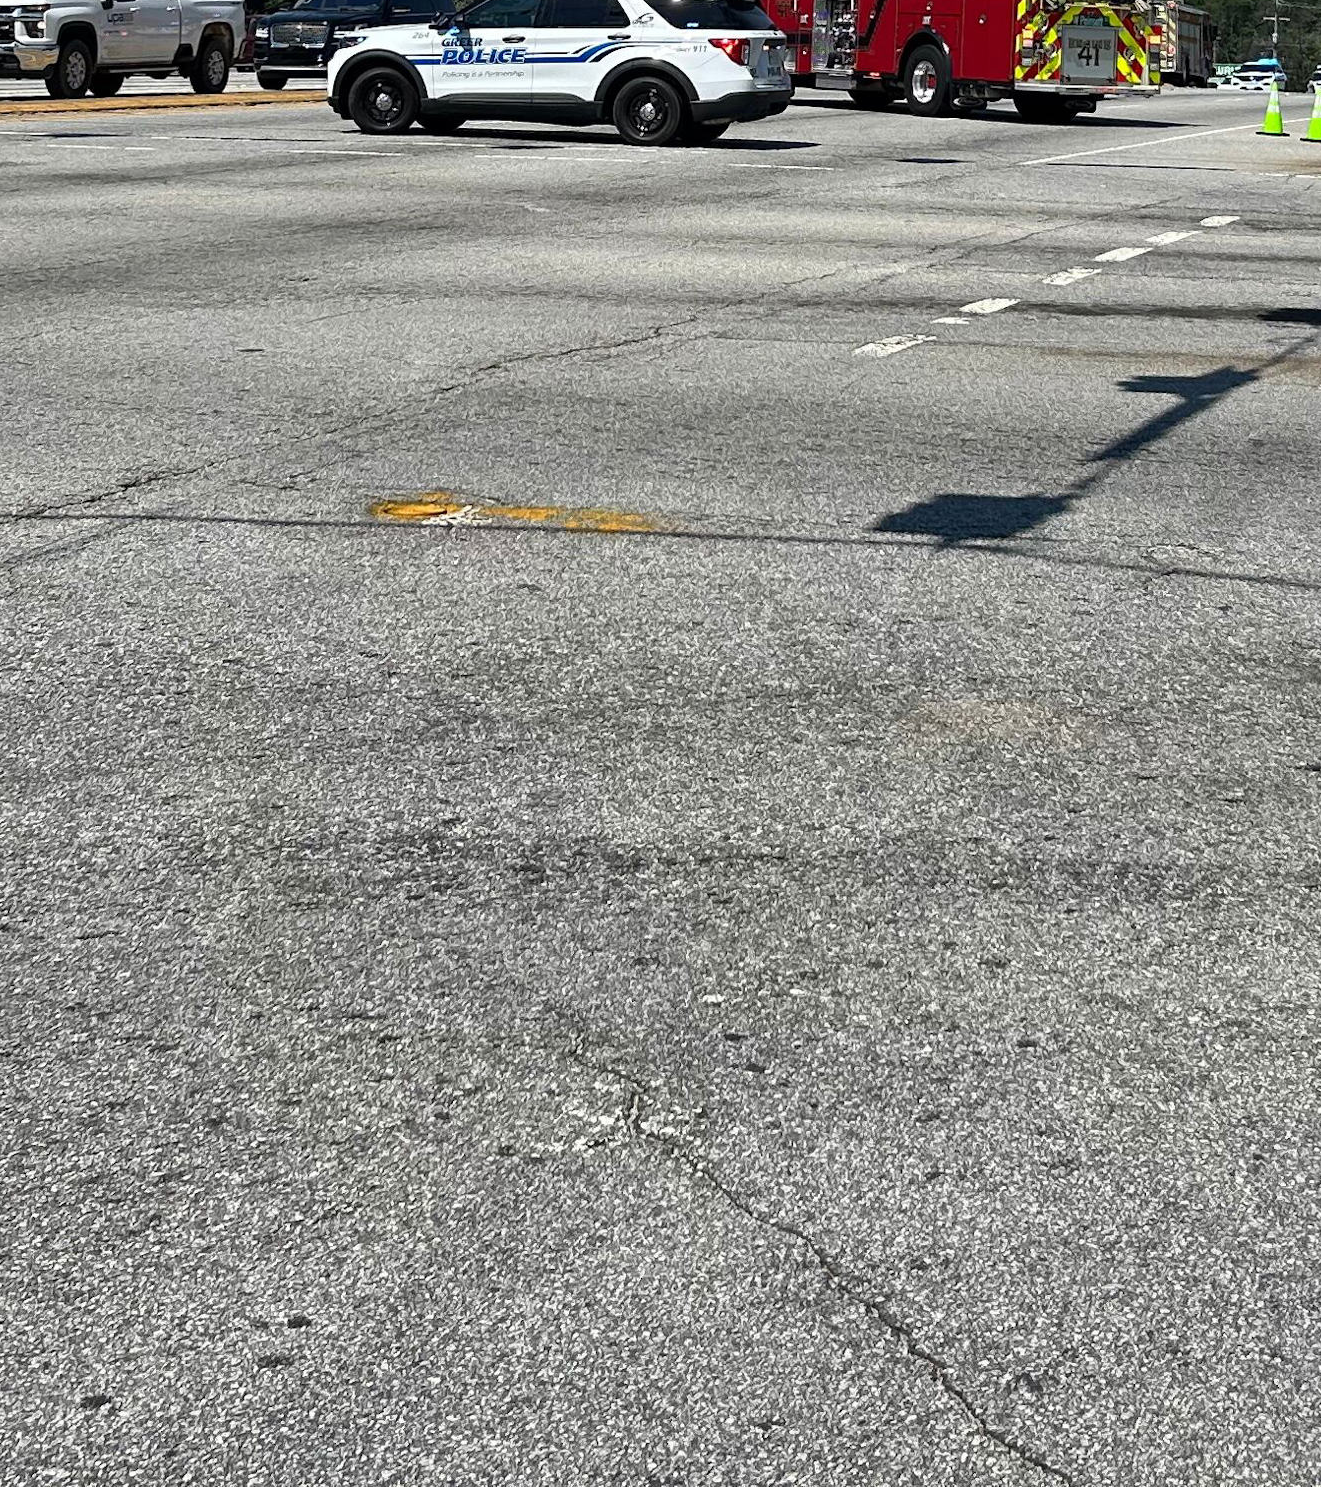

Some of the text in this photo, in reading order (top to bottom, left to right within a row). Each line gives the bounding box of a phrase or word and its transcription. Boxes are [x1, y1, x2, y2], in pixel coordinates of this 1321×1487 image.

[441, 37, 483, 47] GREER
[440, 48, 526, 64] POLICE
[1078, 43, 1100, 67] 41
